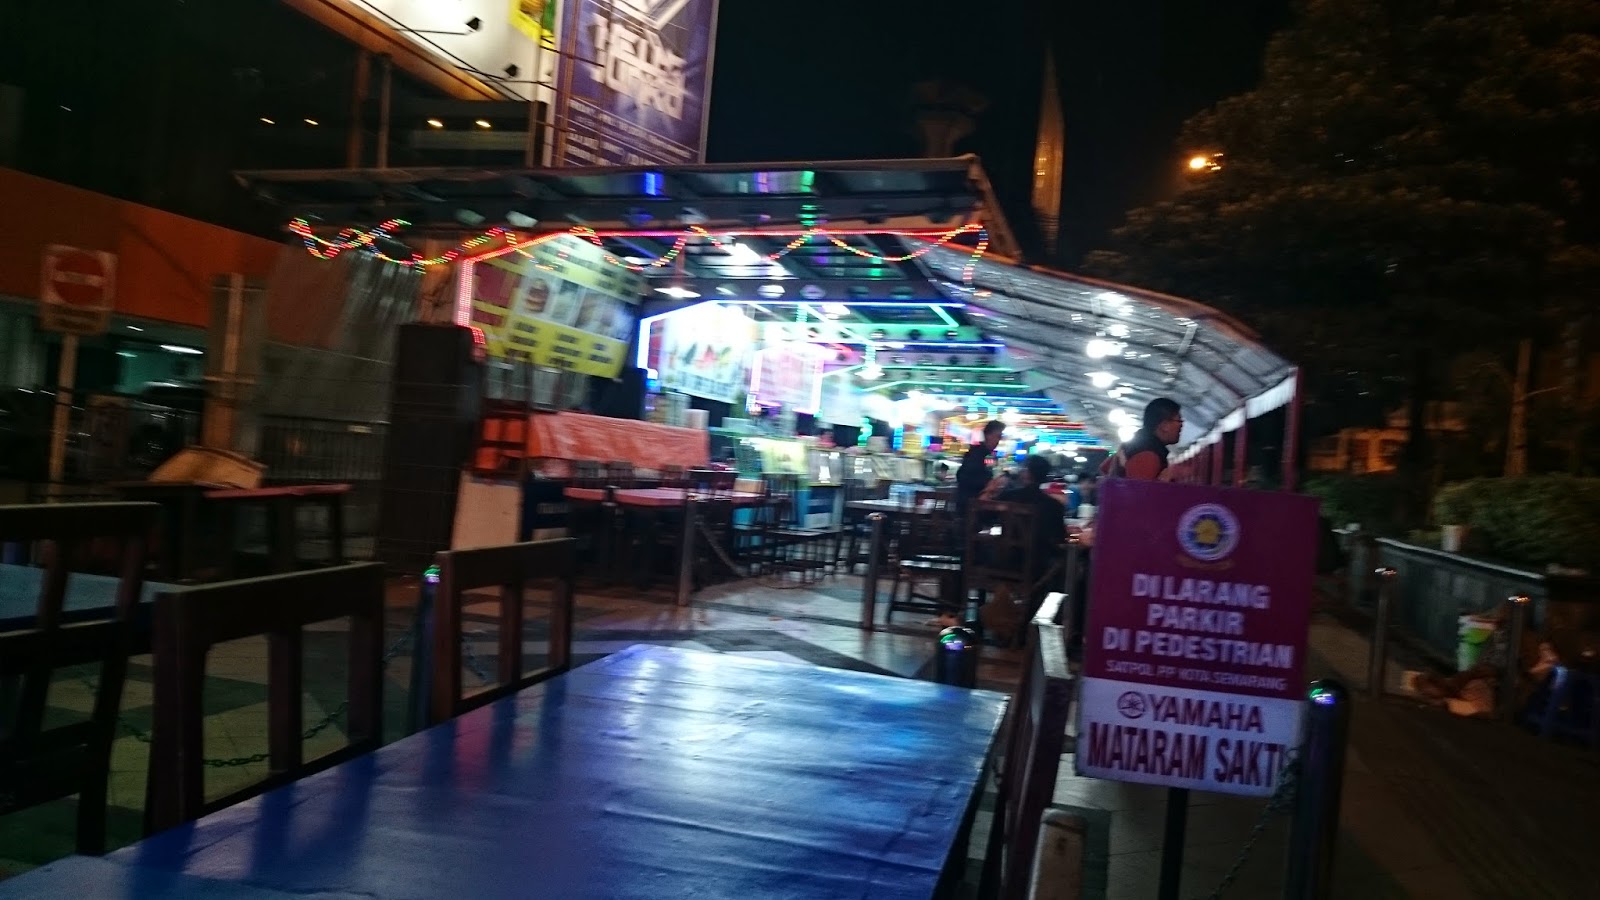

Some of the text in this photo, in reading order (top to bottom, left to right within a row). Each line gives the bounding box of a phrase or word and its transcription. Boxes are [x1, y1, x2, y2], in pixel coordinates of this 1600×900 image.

[1132, 573, 1272, 609] DI LARANG
[1147, 603, 1245, 635] PARKIR
[1103, 626, 1295, 669] DI PEDESTRIAN
[1211, 672, 1288, 690] SEMARANG
[1148, 694, 1264, 733] YAMAHA
[1087, 722, 1208, 780] MATARAM
